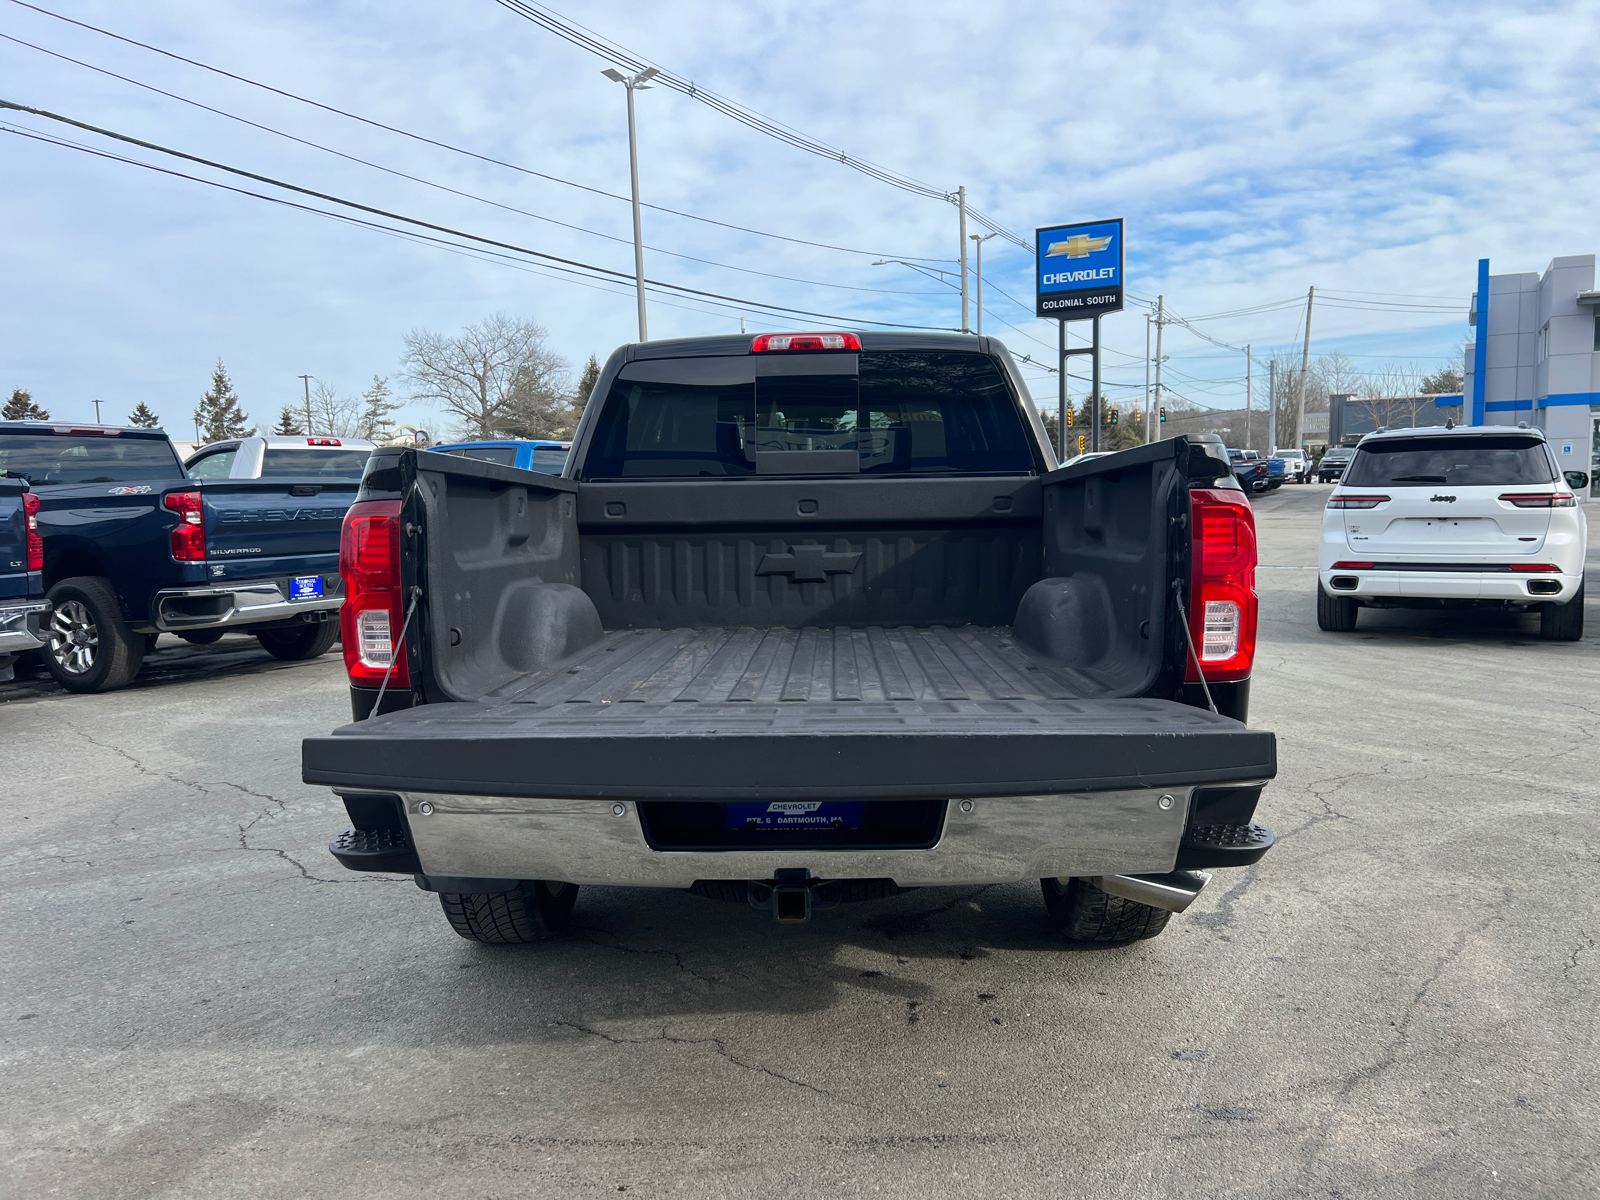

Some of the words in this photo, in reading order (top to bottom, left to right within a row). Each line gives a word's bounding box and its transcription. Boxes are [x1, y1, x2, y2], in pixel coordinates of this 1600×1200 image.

[1043, 267, 1115, 284] CHEVROLET
[1042, 298, 1084, 309] COLONIAL
[1086, 295, 1116, 305] SOUTH
[1430, 494, 1457, 503] Jeep
[210, 547, 262, 555] SILVERADO
